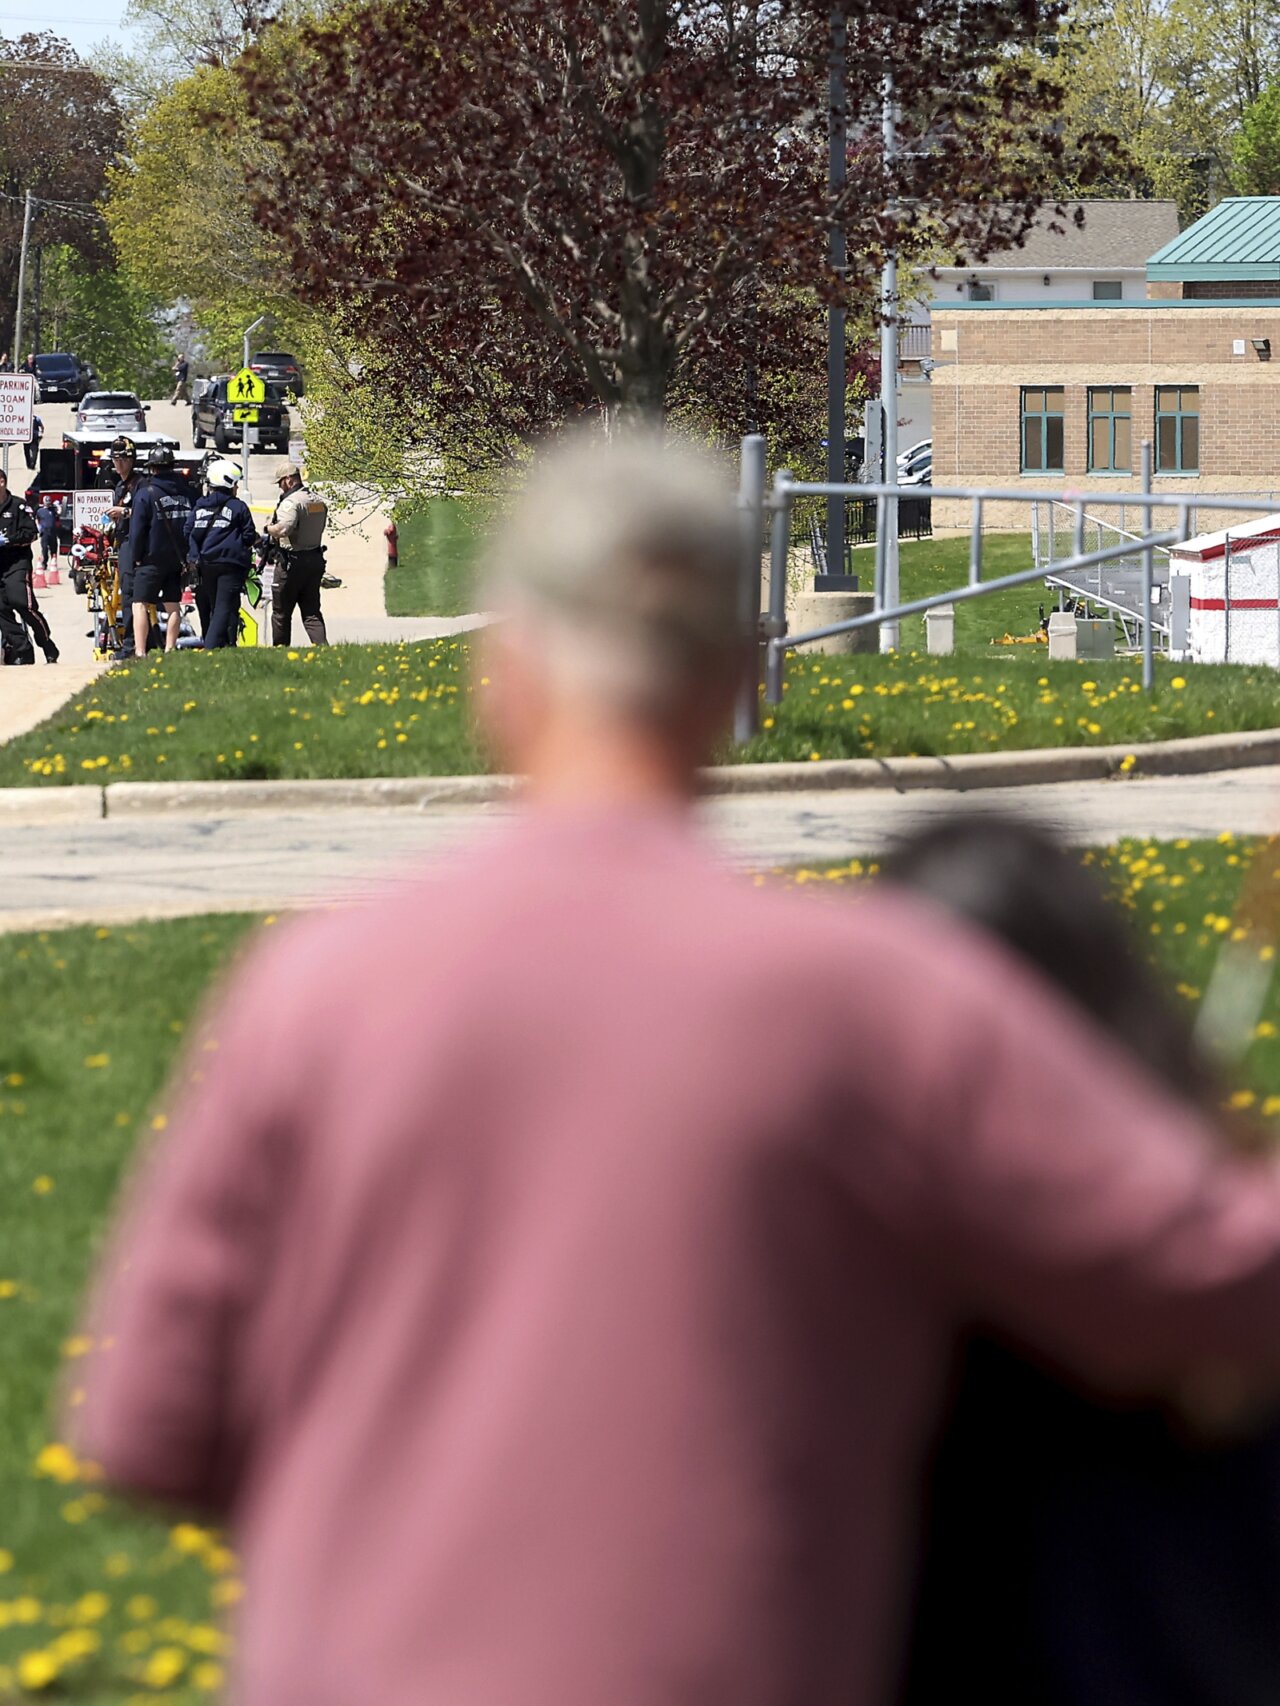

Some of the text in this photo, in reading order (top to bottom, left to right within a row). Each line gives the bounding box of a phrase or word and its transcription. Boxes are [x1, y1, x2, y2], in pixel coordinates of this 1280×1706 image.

[0, 380, 30, 391] PARKING
[2, 404, 14, 413] TO
[16, 428, 29, 436] DAYS
[77, 495, 111, 504] NO PARKING
[89, 514, 100, 522] TO
